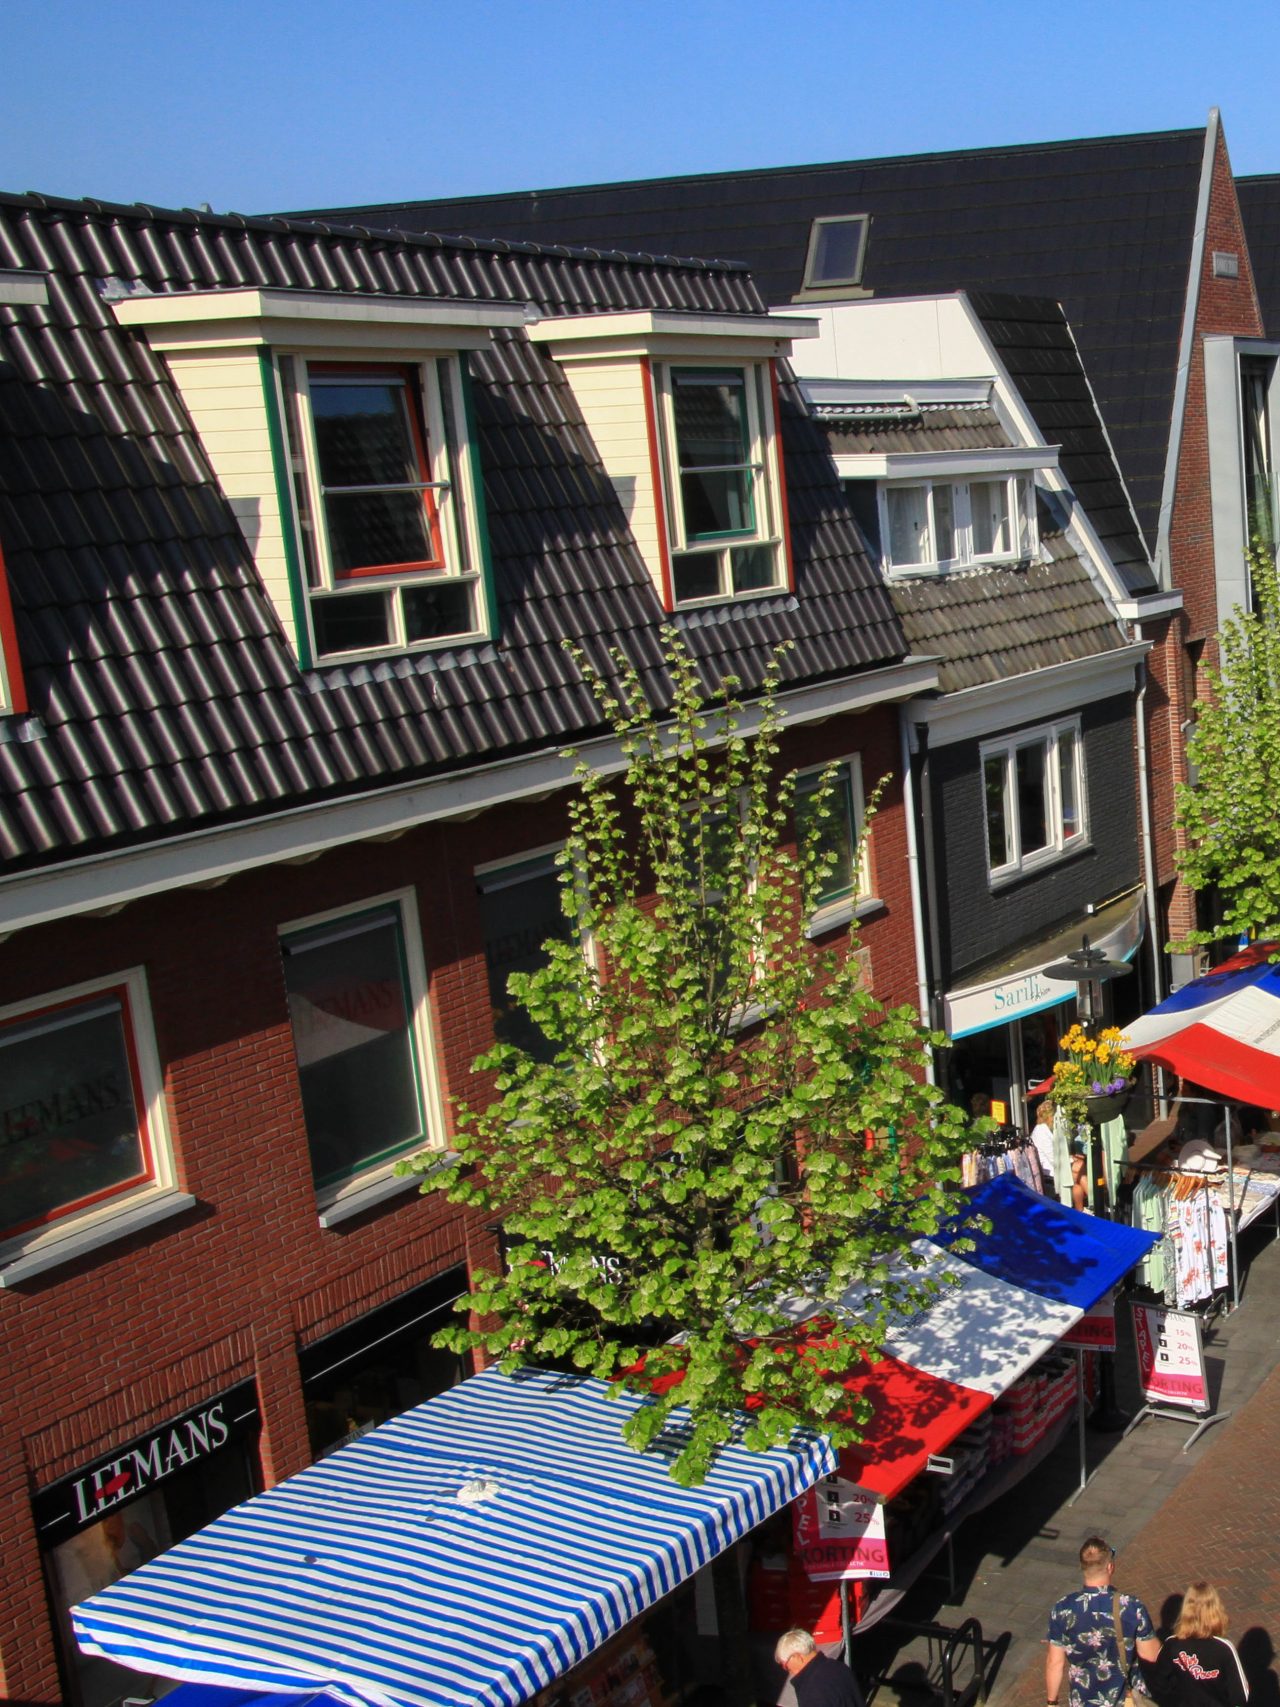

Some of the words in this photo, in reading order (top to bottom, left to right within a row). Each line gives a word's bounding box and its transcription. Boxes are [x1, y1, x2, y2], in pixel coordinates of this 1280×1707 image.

[1177, 1342, 1194, 1351] 20%
[1178, 1356, 1198, 1366] 25%
[73, 1402, 229, 1524] LEEMANS
[854, 1511, 880, 1525] 25%
